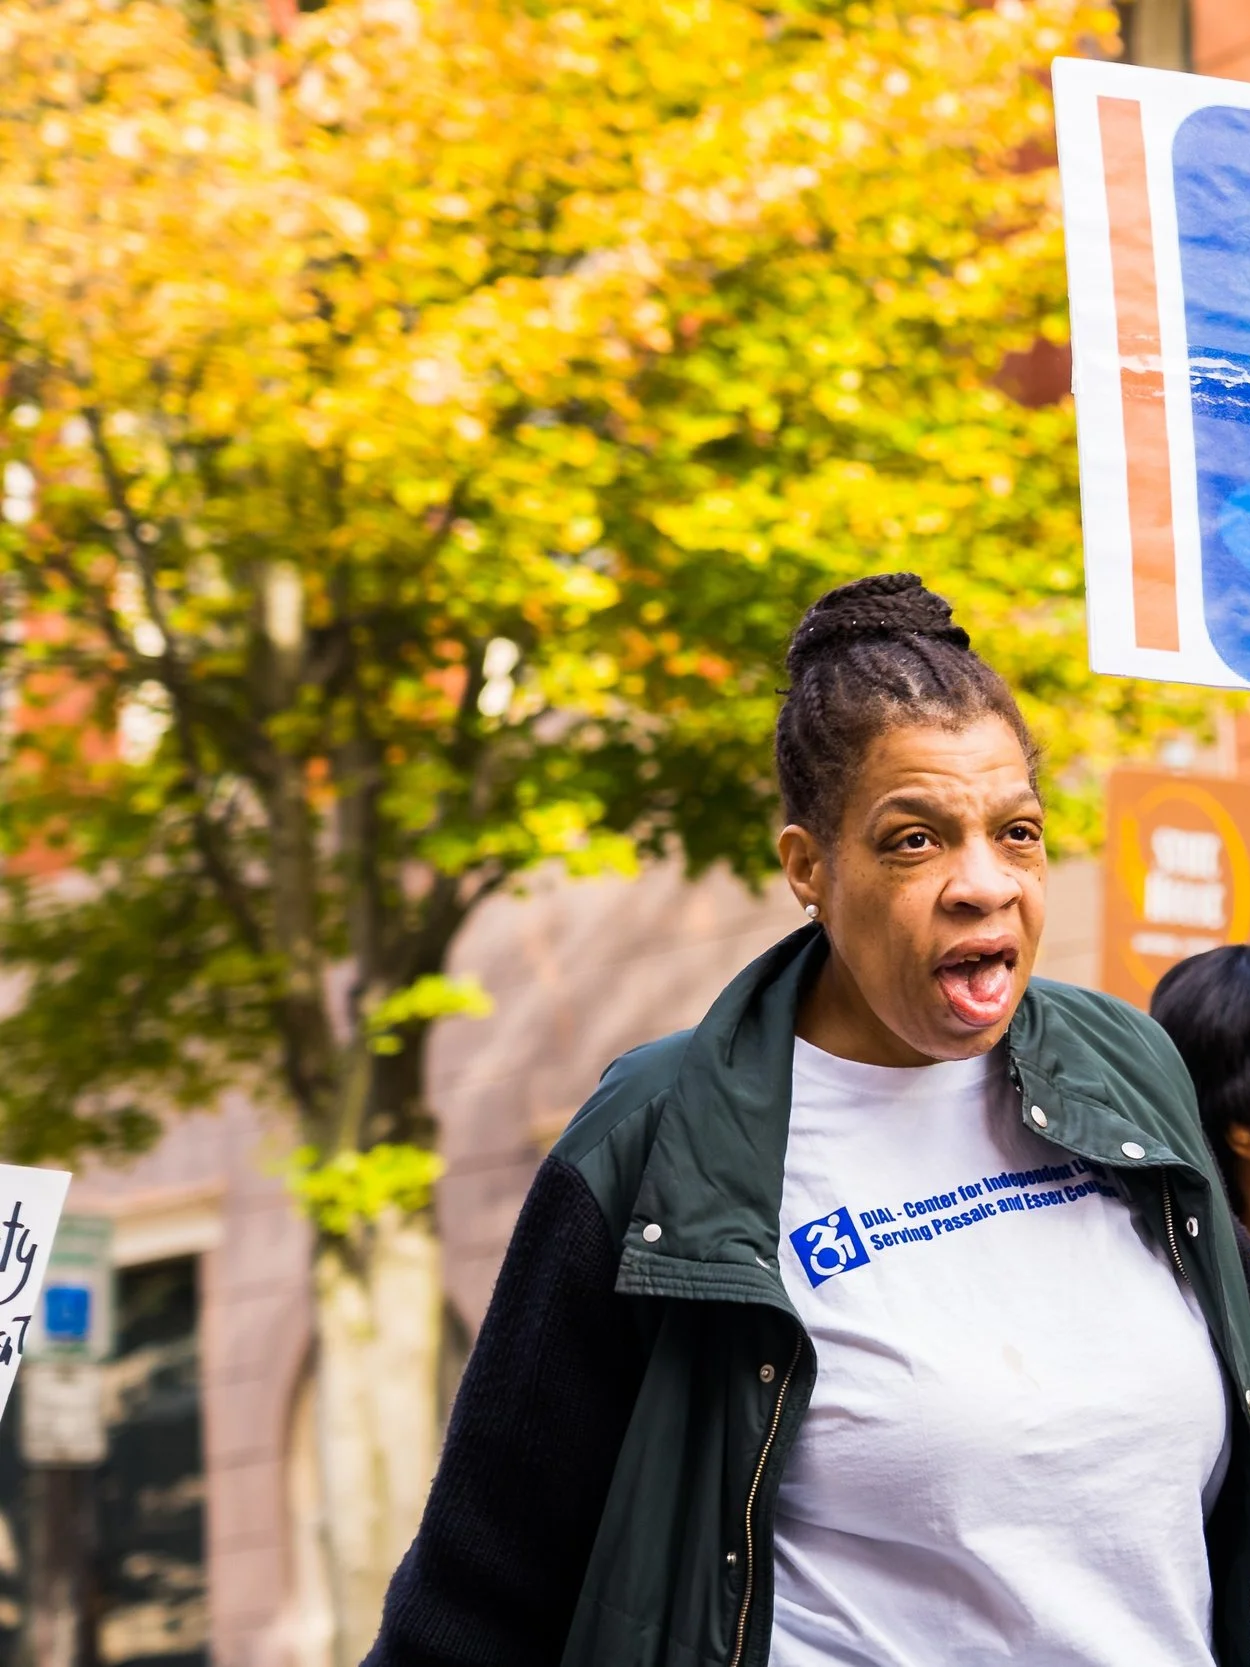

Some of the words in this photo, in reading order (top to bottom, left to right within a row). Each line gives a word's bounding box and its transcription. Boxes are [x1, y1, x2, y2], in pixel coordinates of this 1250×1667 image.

[859, 1207, 897, 1229] DIAL
[903, 1191, 958, 1218] Center
[958, 1182, 983, 1201] for
[982, 1164, 1076, 1192] Independent
[869, 1224, 934, 1251] Serving
[931, 1202, 997, 1235] Passaic
[996, 1193, 1025, 1213] and
[1023, 1187, 1067, 1210] Essex
